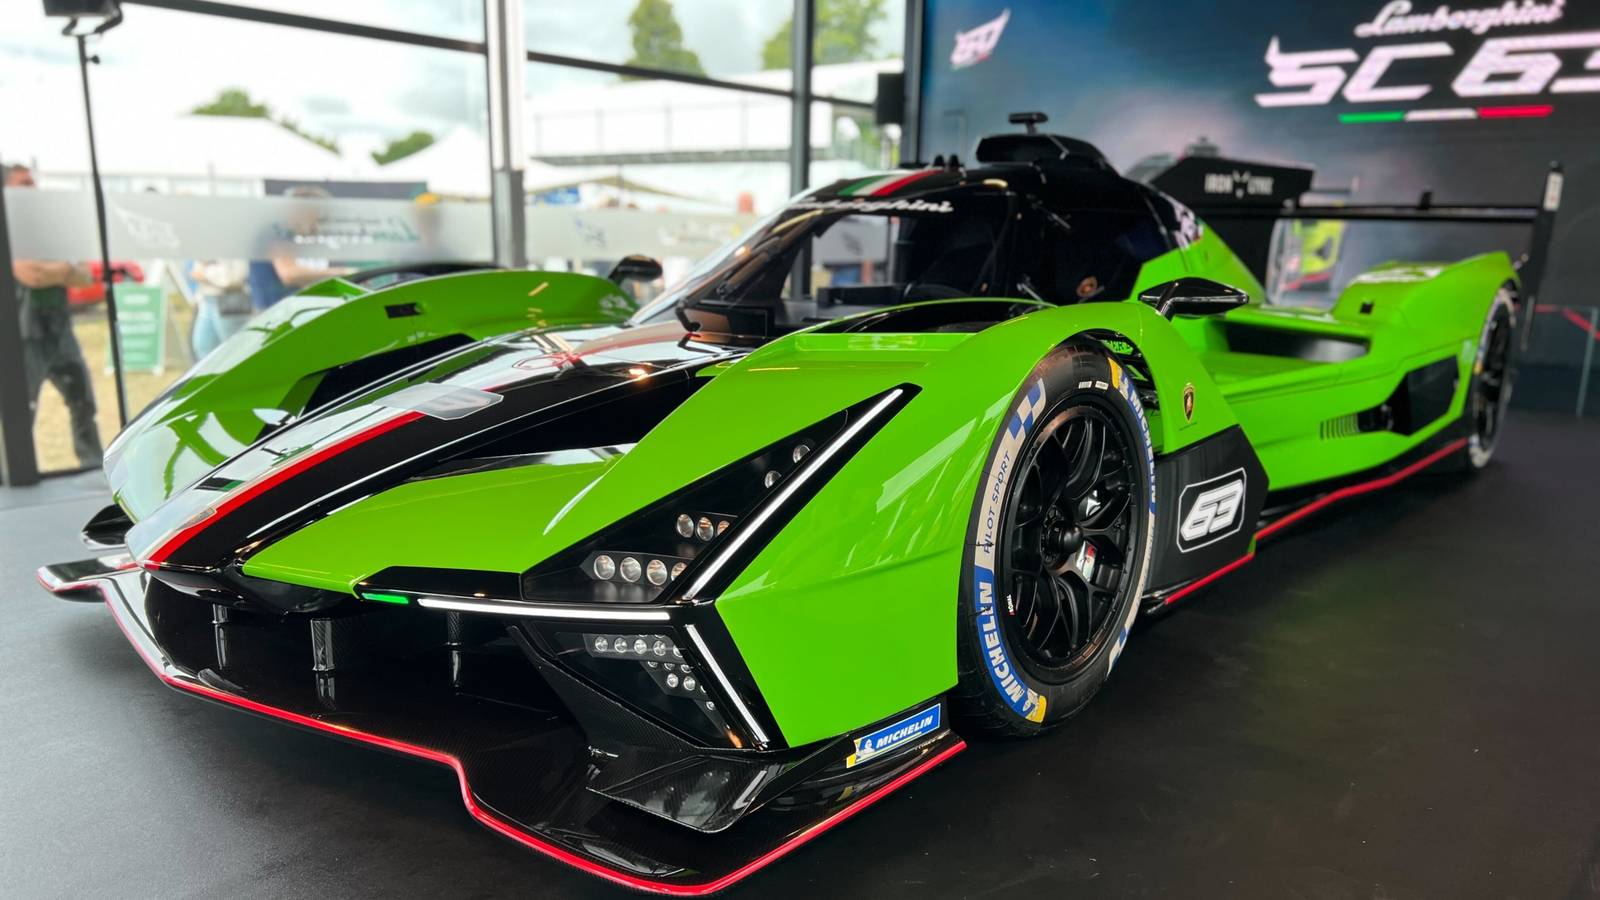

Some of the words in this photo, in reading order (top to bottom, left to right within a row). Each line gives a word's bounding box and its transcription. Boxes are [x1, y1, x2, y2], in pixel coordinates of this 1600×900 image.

[1354, 0, 1566, 38] Lamborghini
[1254, 35, 1454, 107] SC
[983, 506, 996, 555] PILOT
[991, 449, 1011, 504] SPORT
[1180, 479, 1244, 541] 63
[978, 581, 1026, 704] MICHELIN
[875, 715, 934, 750] MICHELIN
